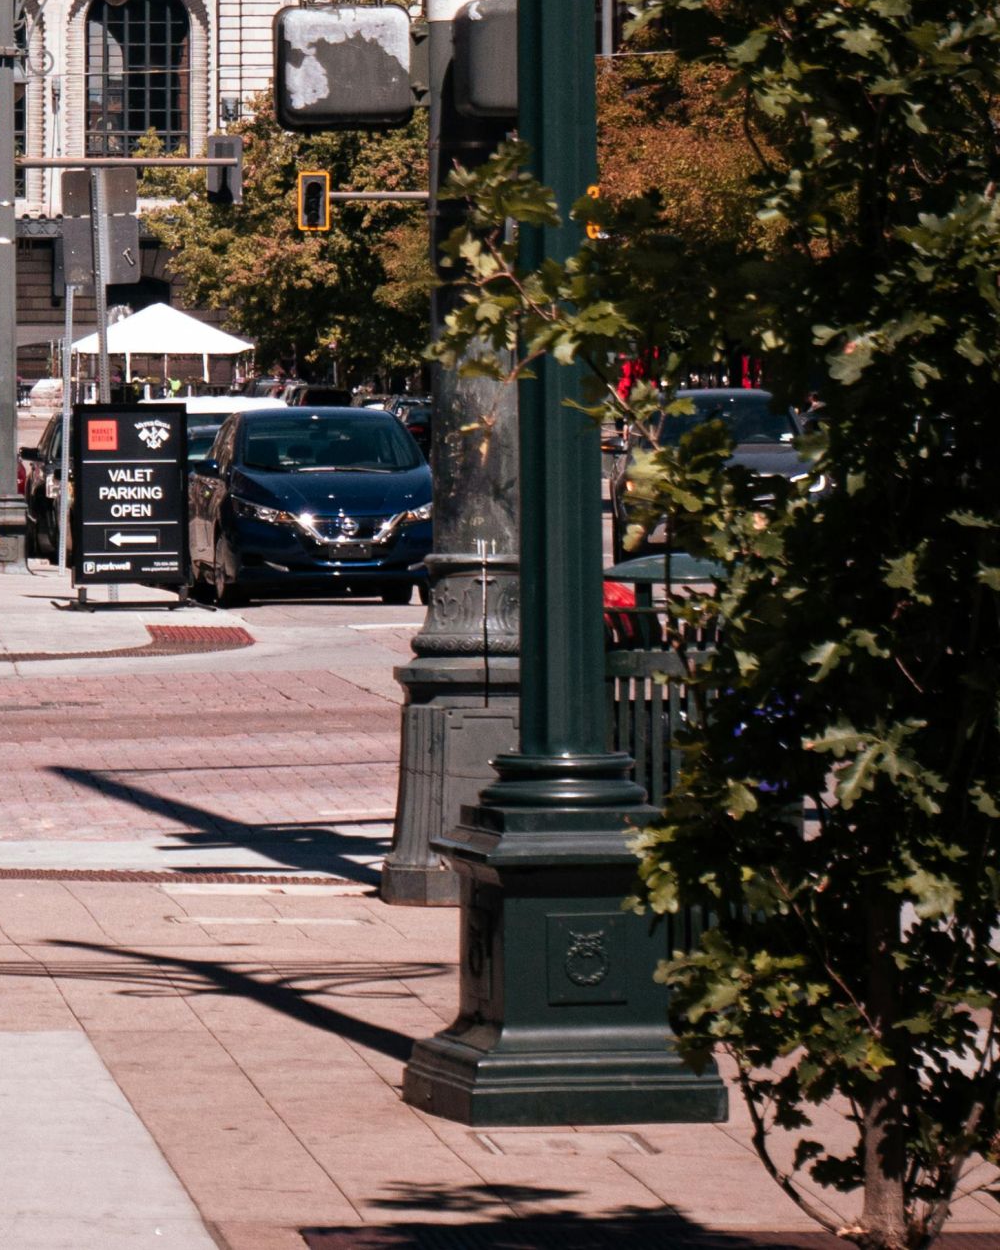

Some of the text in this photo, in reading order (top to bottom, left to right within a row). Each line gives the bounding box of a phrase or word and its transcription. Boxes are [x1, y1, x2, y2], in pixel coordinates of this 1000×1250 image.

[108, 469, 154, 482] VALET
[99, 486, 163, 500] PARKING
[110, 504, 152, 518] OPEN
